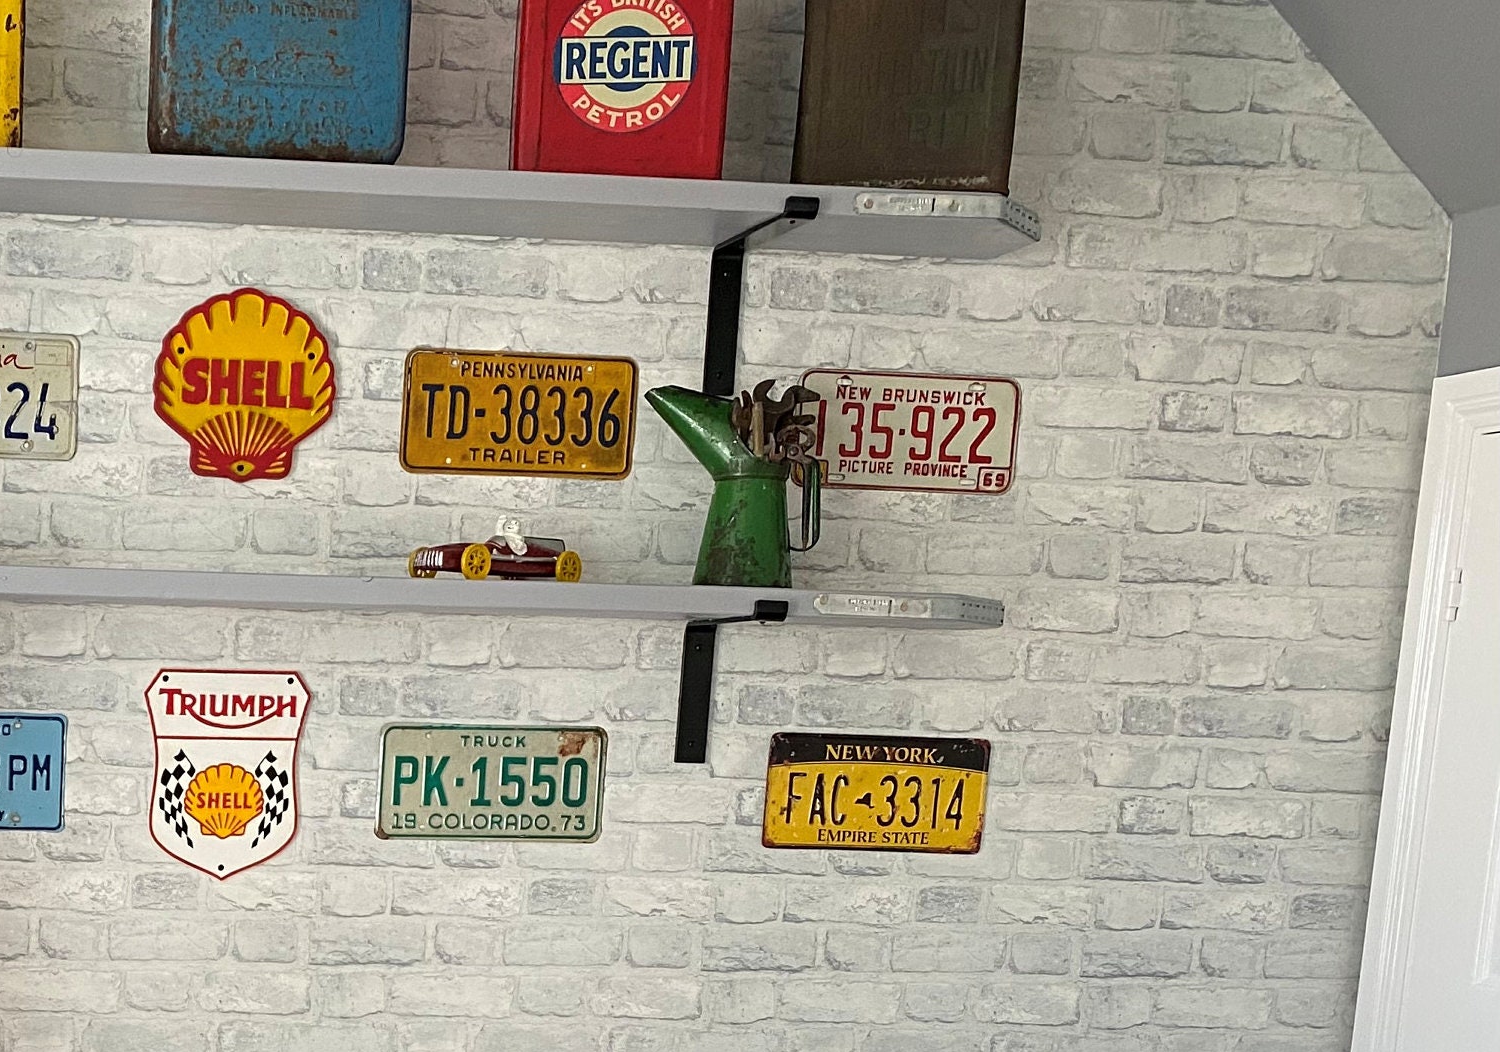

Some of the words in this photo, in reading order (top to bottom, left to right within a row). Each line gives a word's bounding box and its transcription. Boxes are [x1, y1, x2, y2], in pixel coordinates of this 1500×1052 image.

[565, 40, 690, 80] REGENT
[572, 92, 681, 128] PETROL
[460, 361, 584, 382] PENNSYLVANIA
[181, 357, 314, 410] SHELL
[836, 386, 872, 401] NEW
[882, 388, 986, 406] BRUNSWICK
[421, 383, 621, 448] TD-38336
[469, 447, 566, 465] TRAILER
[838, 460, 894, 474] PICTURE
[904, 462, 968, 478] PROVINCE
[982, 473, 1005, 487] 69
[158, 688, 297, 728] TRIUMPH
[460, 735, 527, 748] TRUCK
[825, 744, 878, 761] NEW
[882, 747, 936, 764] YORK
[8, 754, 52, 791] PM
[197, 791, 253, 809] SHELL
[784, 772, 850, 826] FAC
[876, 774, 966, 830] 3314
[391, 813, 417, 830] 19
[428, 813, 550, 831] COLORADO
[560, 814, 586, 831] 73
[817, 828, 878, 844] EMPIRE
[881, 830, 930, 845] STATE
